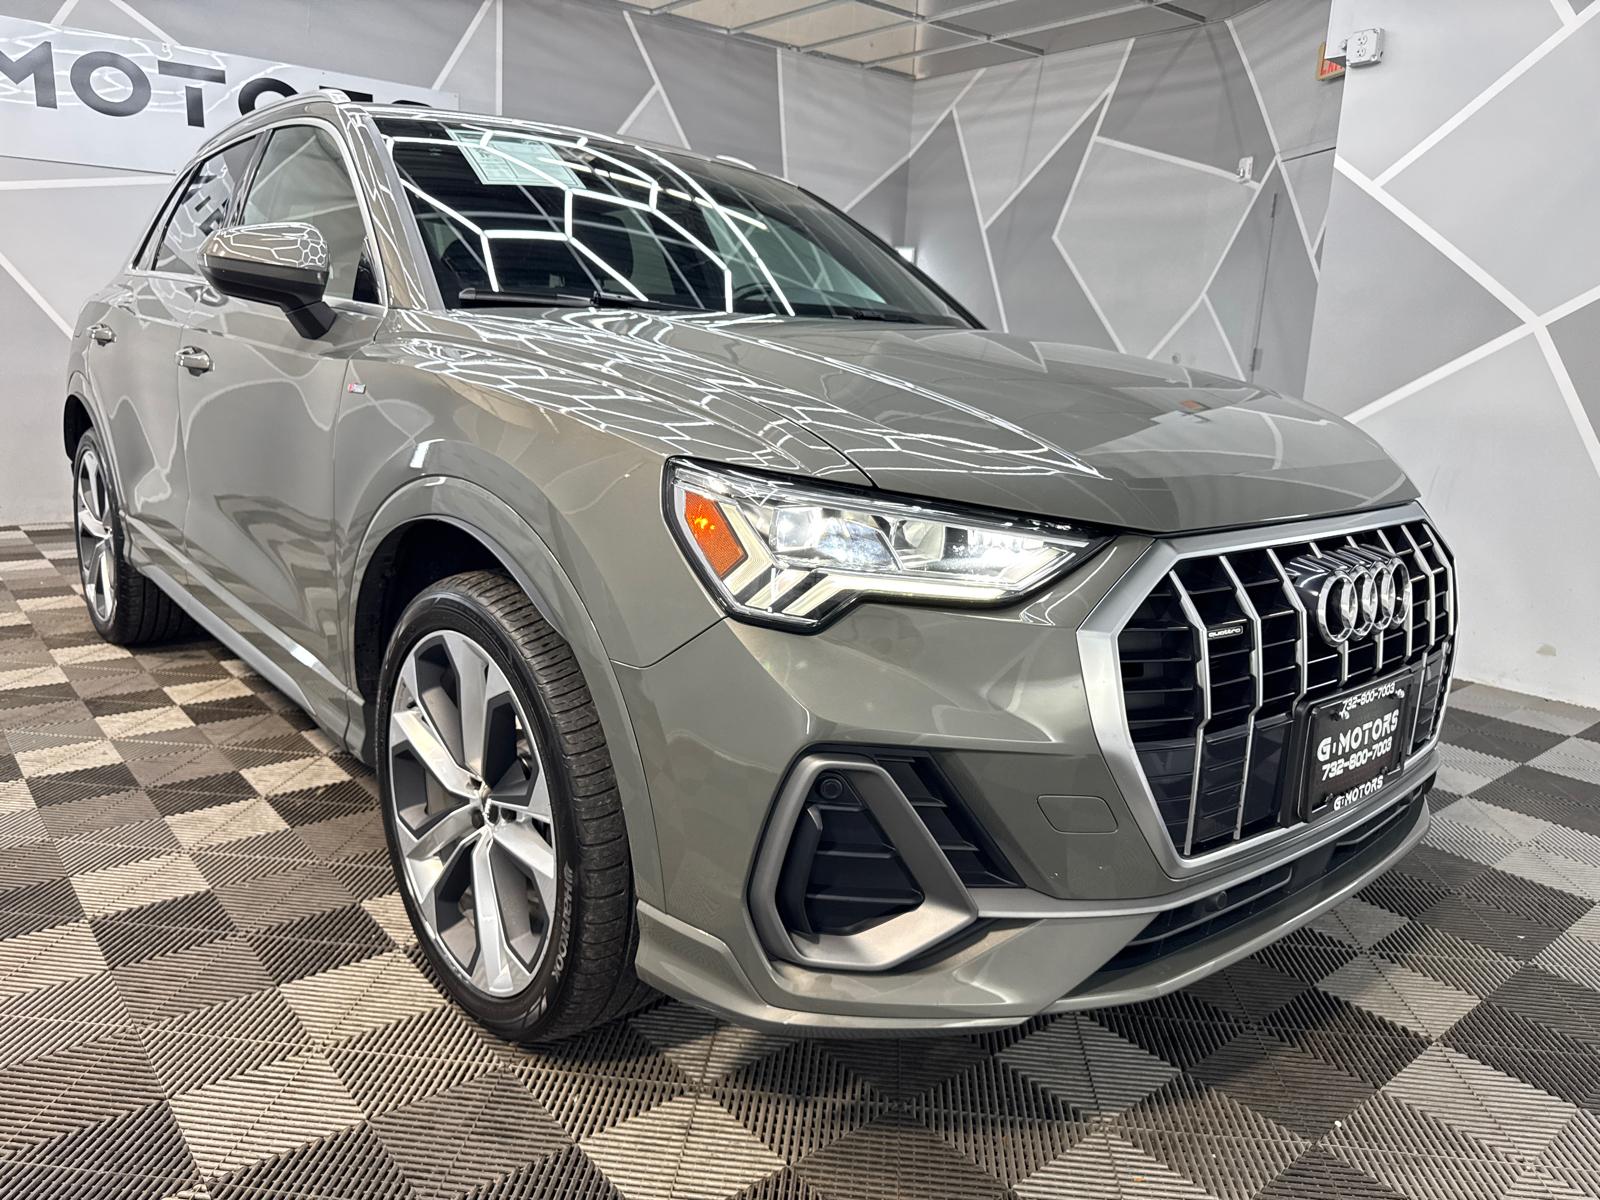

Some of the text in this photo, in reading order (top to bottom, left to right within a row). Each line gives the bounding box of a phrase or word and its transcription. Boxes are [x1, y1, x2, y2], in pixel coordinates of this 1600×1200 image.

[1208, 627, 1241, 638] quattro
[1342, 682, 1396, 712] 732-800-7003
[1322, 736, 1393, 781] 732-800-7003
